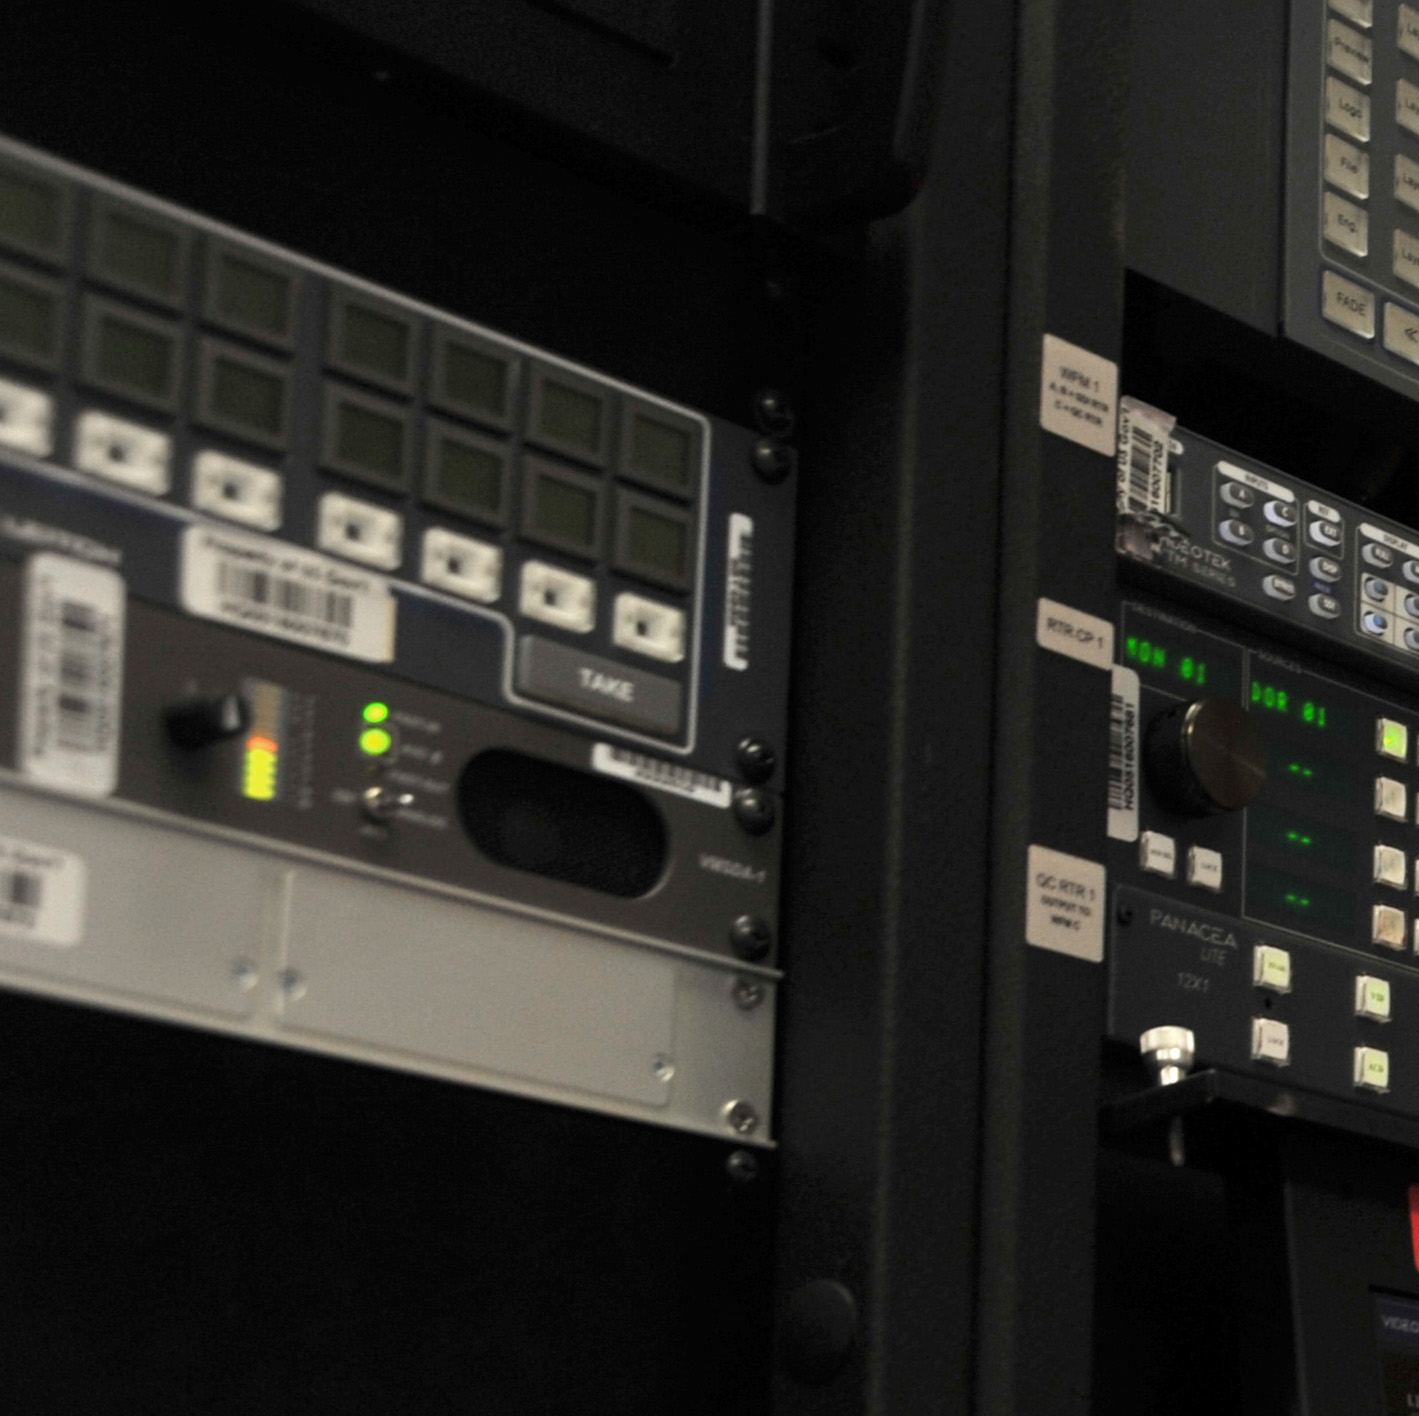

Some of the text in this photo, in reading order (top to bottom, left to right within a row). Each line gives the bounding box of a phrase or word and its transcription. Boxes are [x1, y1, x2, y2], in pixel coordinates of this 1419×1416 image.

[1336, 291, 1366, 317] FADE
[1180, 657, 1206, 685] 01
[580, 667, 636, 703] TAKE
[1303, 701, 1327, 728] 01
[1149, 908, 1238, 950] PANACEA
[1200, 947, 1228, 965] LITE
